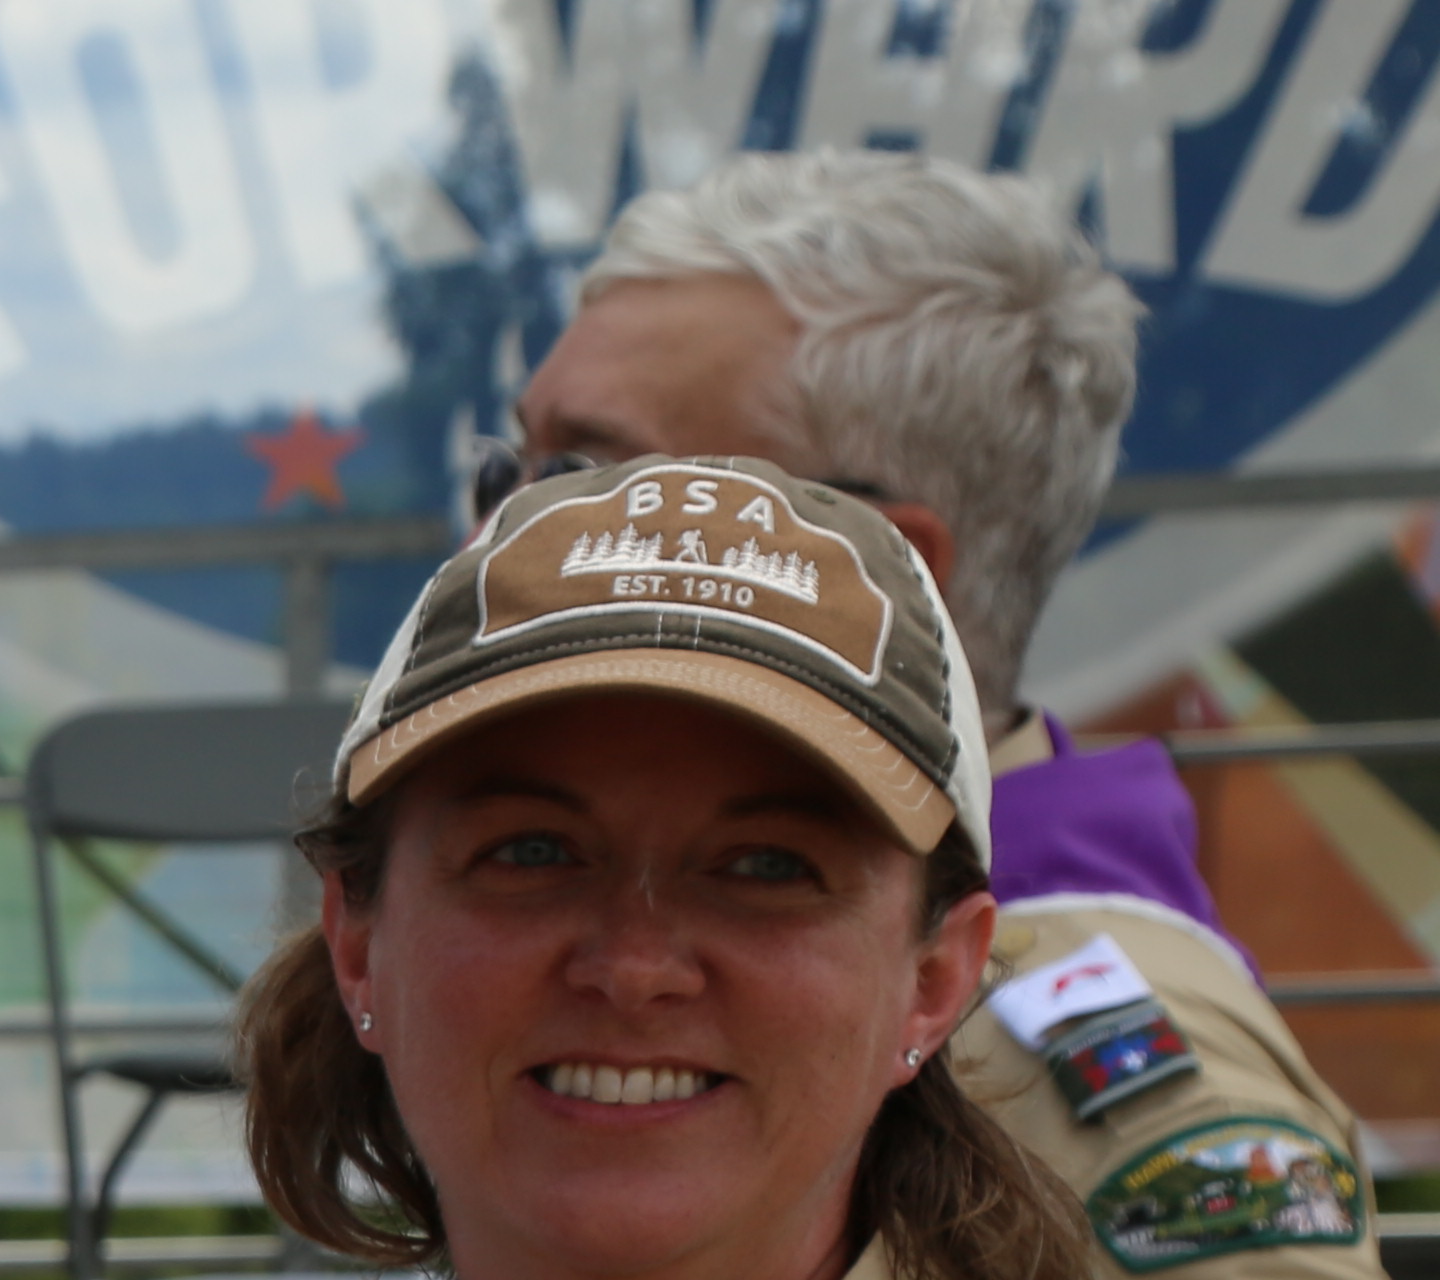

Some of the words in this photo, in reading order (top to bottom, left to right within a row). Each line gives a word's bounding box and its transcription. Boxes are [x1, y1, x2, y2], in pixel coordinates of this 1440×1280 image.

[626, 480, 776, 534] BSA
[612, 575, 670, 597] EST.
[682, 577, 755, 608] 1910
